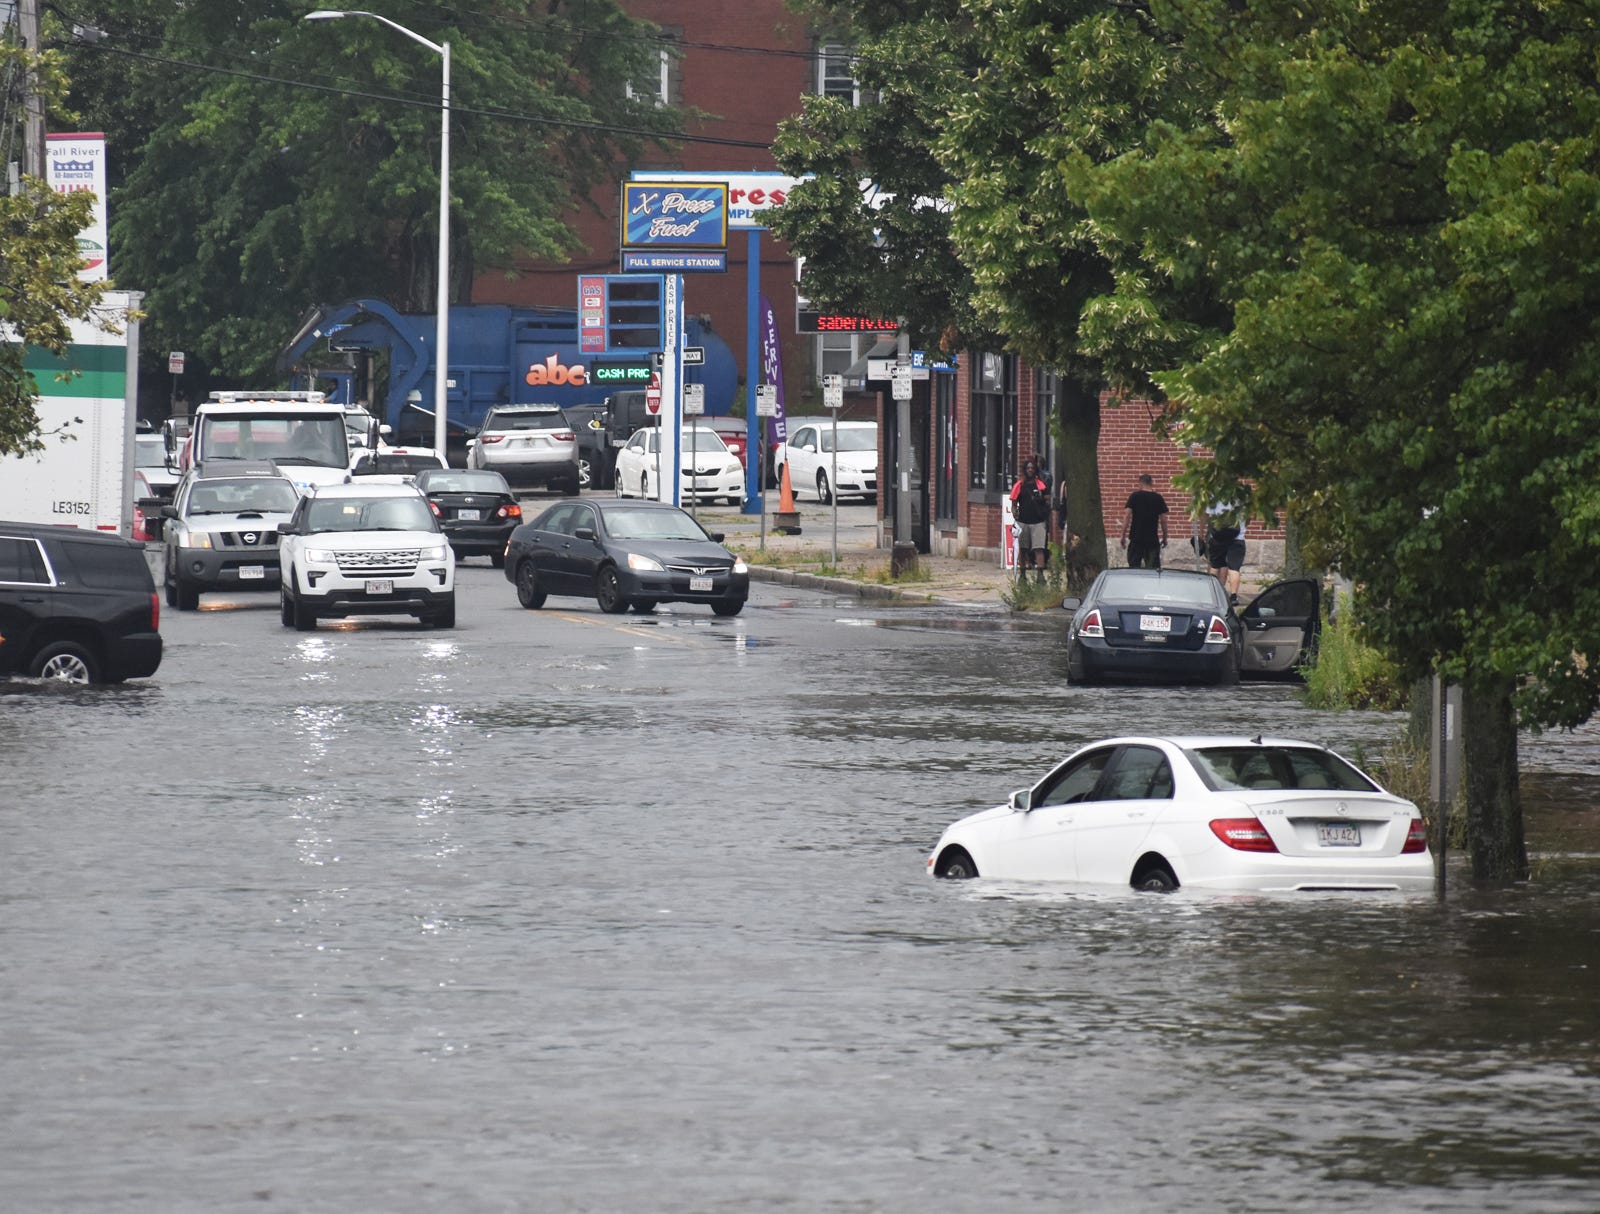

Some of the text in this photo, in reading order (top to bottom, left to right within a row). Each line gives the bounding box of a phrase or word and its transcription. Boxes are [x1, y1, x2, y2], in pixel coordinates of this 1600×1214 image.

[46, 148, 100, 156] Fall River
[632, 192, 715, 215] X Press
[649, 217, 700, 237] Fuel
[629, 258, 720, 266] FULL SERVICE STATION
[583, 286, 602, 295] GAS
[525, 352, 585, 386] abc
[597, 368, 625, 378] CASH
[767, 310, 786, 438] SERVCE
[53, 501, 90, 514] LE3152
[1321, 829, 1357, 840] 1KJ 427
